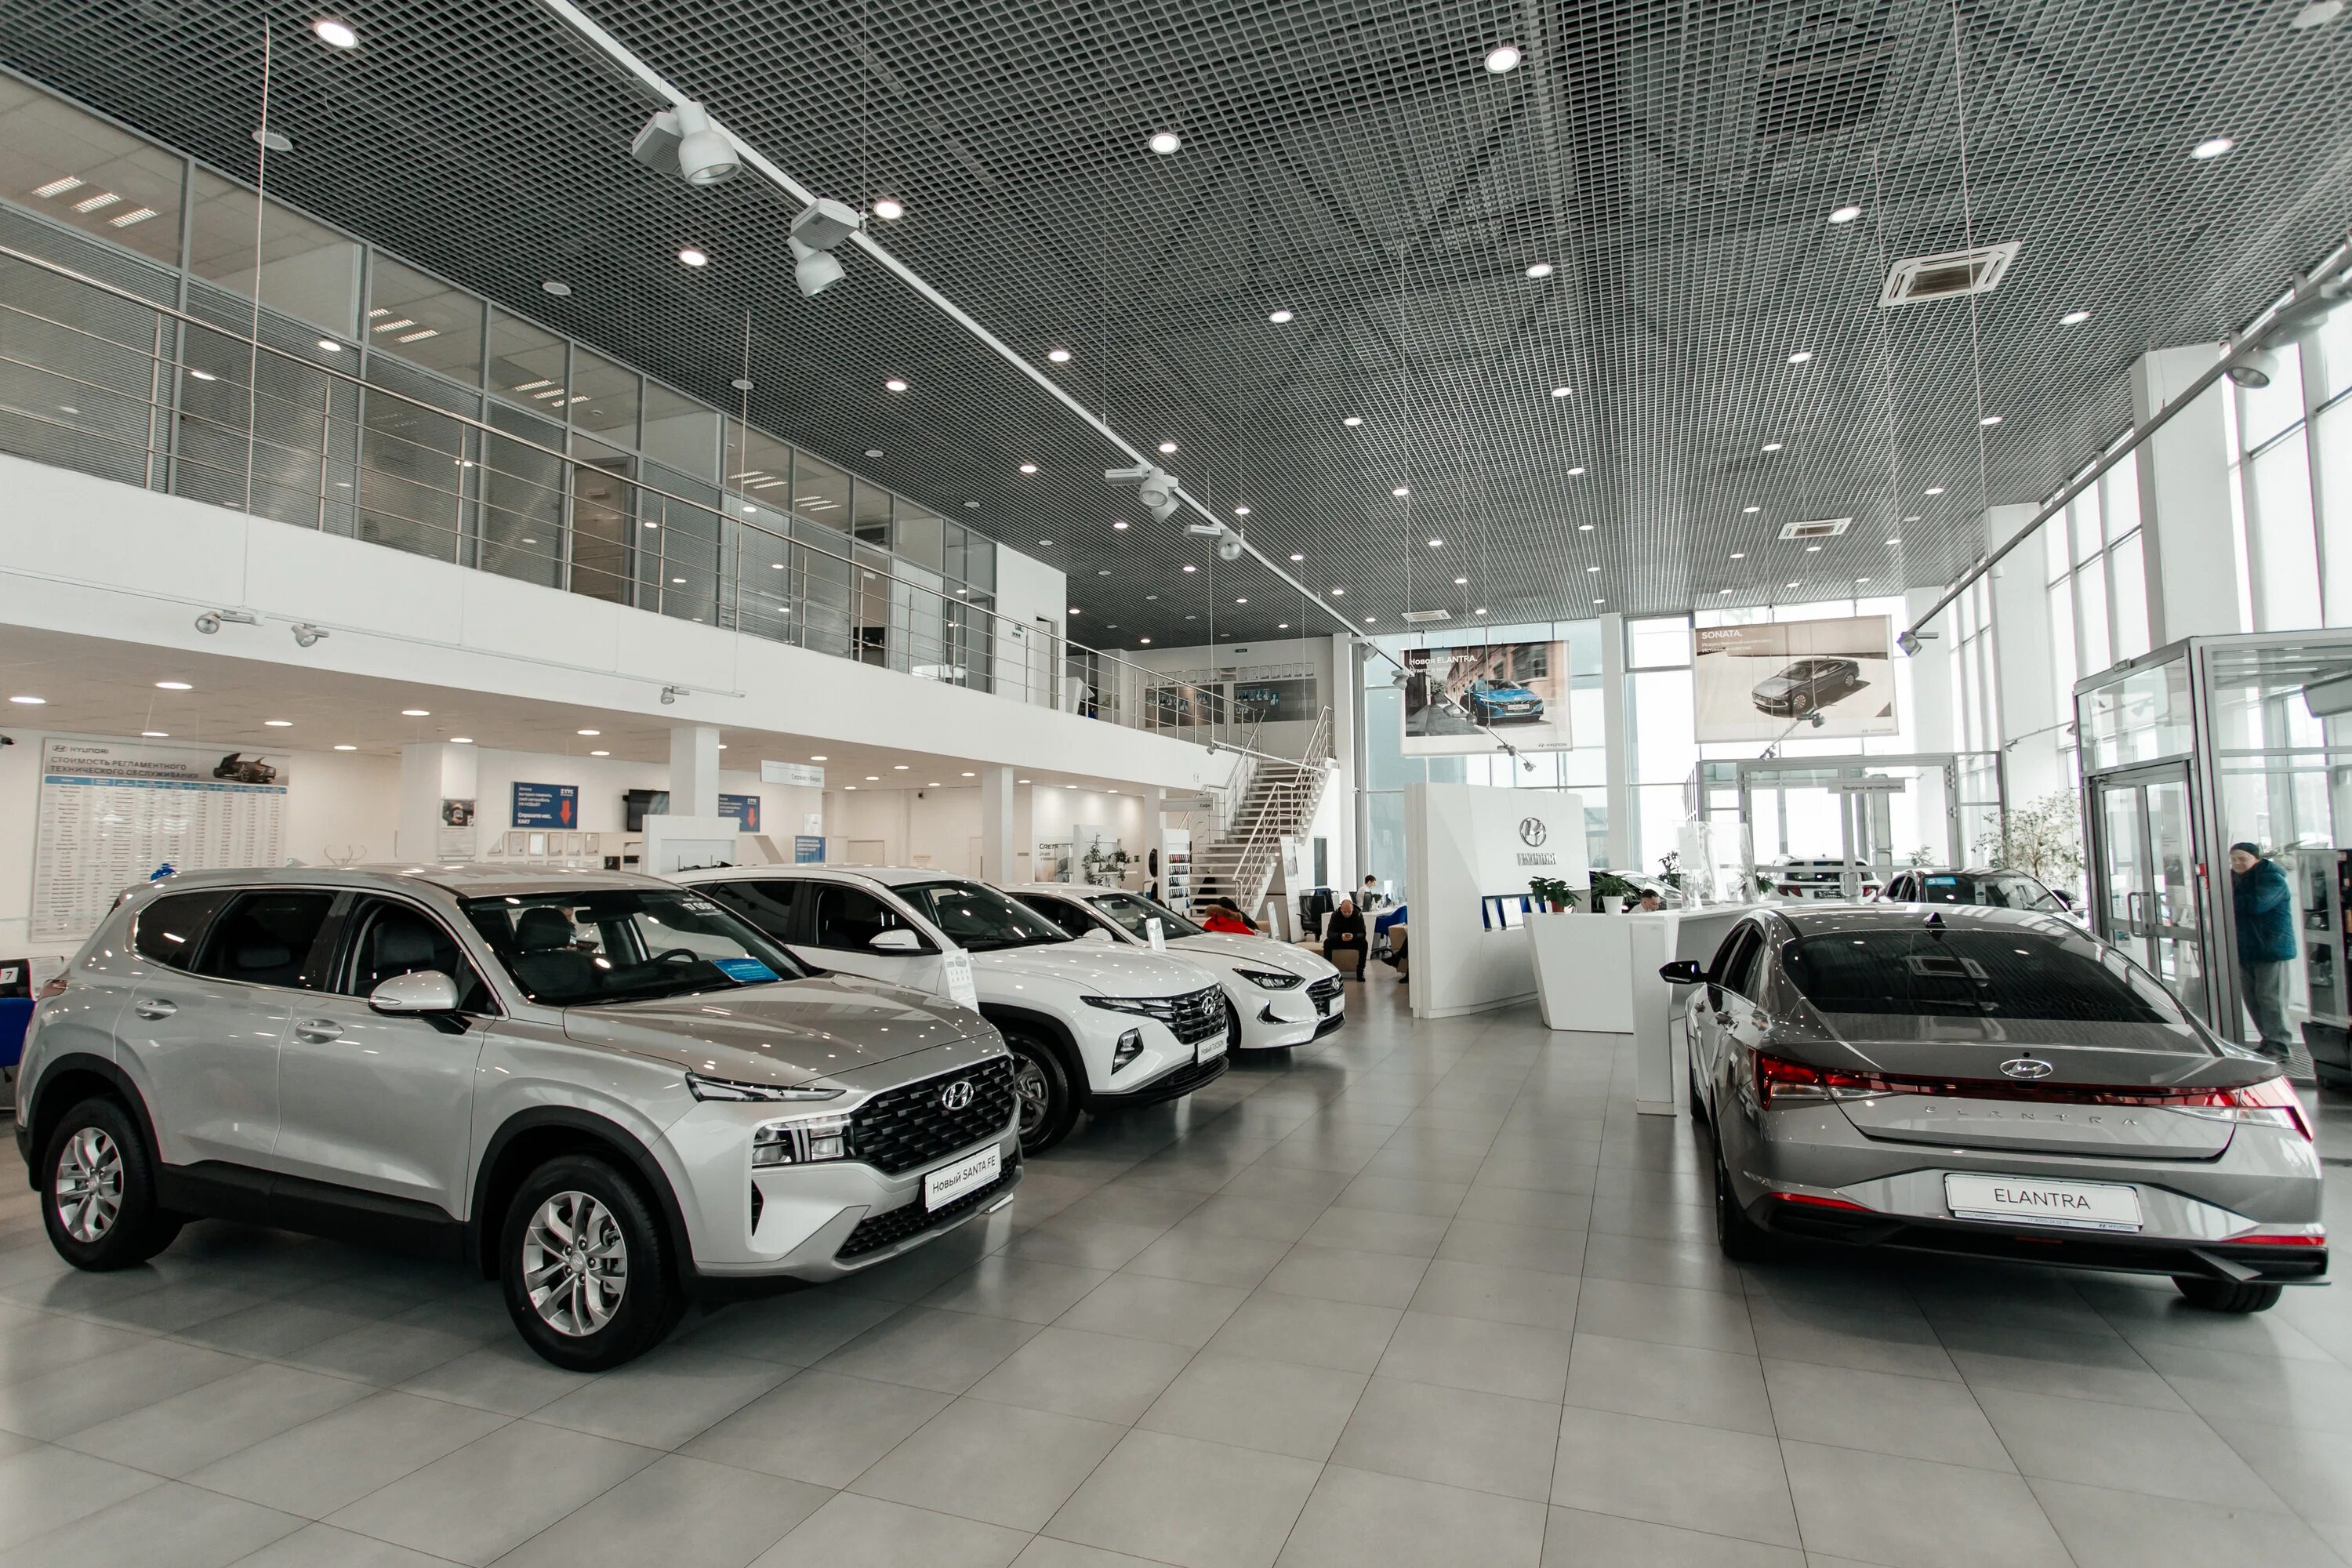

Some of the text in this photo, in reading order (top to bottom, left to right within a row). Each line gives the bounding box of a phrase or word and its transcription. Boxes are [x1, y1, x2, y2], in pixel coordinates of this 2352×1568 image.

[1701, 630, 1743, 640] SONATA.
[1437, 655, 1478, 664] ELANTRA.
[51, 757, 187, 771] СТОИМОСТЬ РЕГЛАМЕНТНОГО
[50, 765, 199, 779] ТЕХНИЧЕСКОГО ОБСЛУЖИВАНИЯ
[6, 971, 13, 980] 7
[1925, 1105, 2138, 1125] ELANTRA
[963, 1160, 986, 1181] SANTA
[987, 1155, 996, 1168] FE
[1994, 1188, 2091, 1210] ELANTRA
